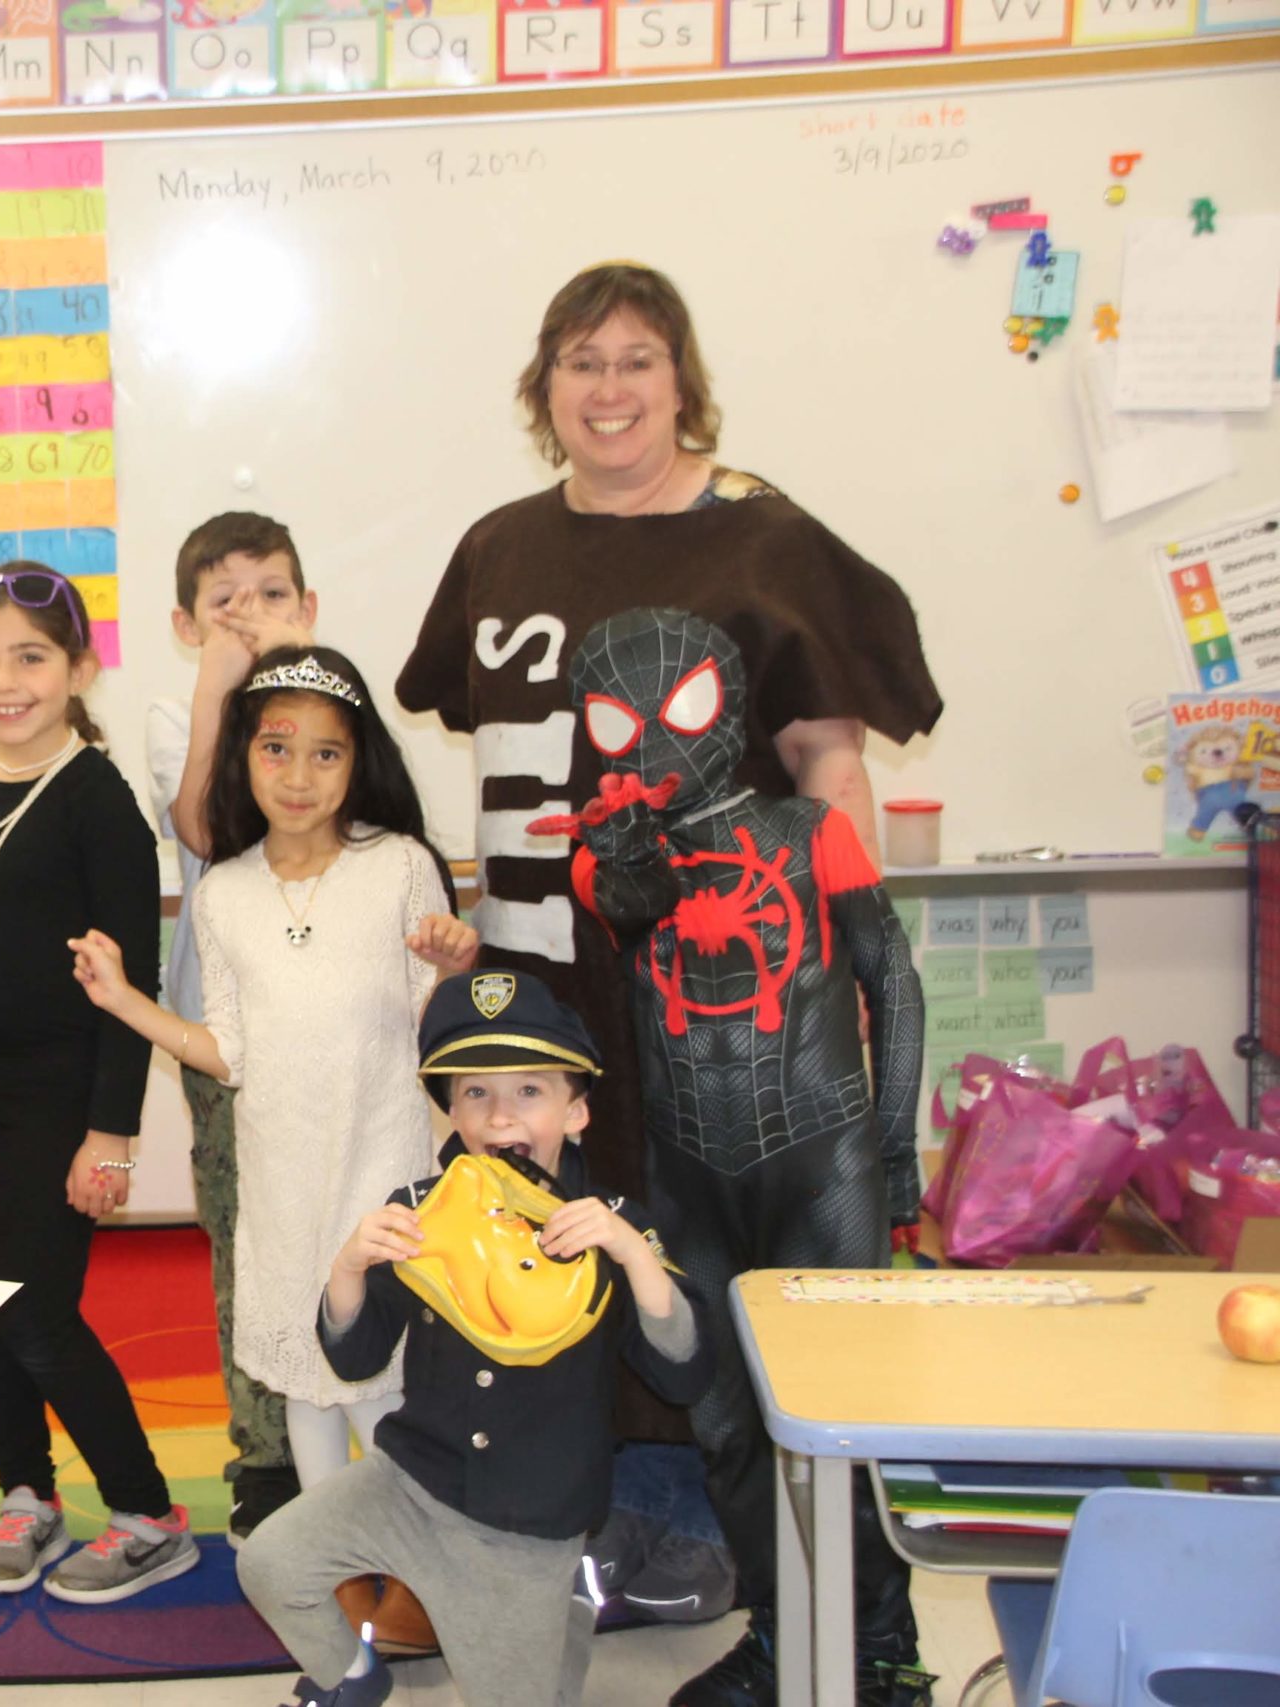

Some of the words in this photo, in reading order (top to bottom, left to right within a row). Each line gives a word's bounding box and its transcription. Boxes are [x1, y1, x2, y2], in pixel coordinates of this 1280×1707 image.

[83, 38, 143, 77] Nn
[190, 33, 252, 71] Oo
[307, 27, 360, 75] Pp
[406, 22, 472, 71] Qq
[525, 17, 580, 55] Rr
[639, 10, 693, 49] Ss
[751, 3, 807, 42] Tt
[865, 0, 925, 33] Uu
[832, 132, 969, 176] 3/9/2020
[157, 167, 289, 212] Monday,
[299, 155, 392, 195] March
[60, 287, 102, 325] 40
[26, 440, 61, 475] 69
[76, 442, 111, 475] 70
[1180, 570, 1201, 589] 4
[1189, 591, 1206, 614] 3
[935, 917, 976, 935] was
[989, 905, 1029, 942] why
[1047, 915, 1081, 941] you
[990, 958, 1031, 983] who
[1046, 963, 1090, 990] your
[935, 1004, 984, 1032] want
[993, 1000, 1039, 1030] what
